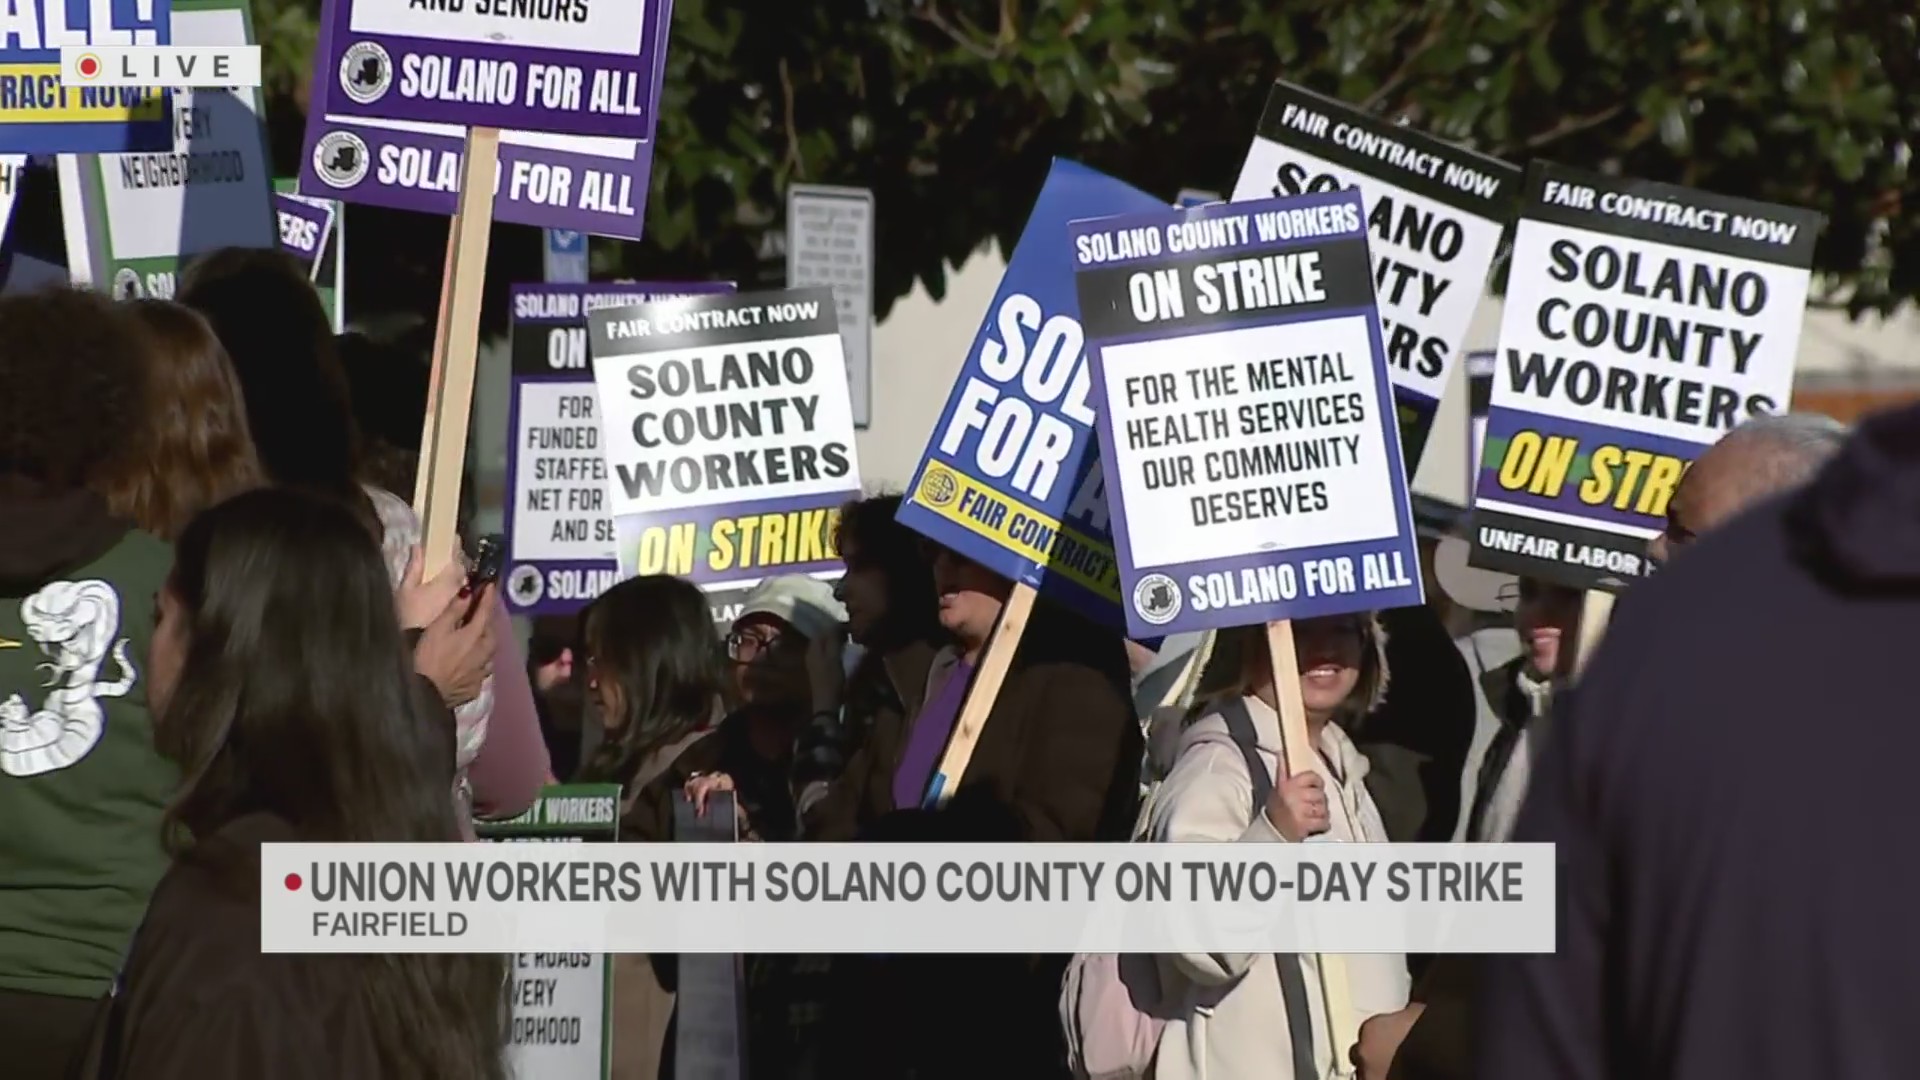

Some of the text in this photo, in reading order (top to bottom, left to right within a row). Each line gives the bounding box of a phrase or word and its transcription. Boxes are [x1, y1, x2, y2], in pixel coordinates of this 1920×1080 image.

[400, 53, 517, 106] SOLANO
[526, 64, 582, 110] FOR
[589, 70, 641, 115] ALL
[1281, 104, 1501, 199] FAIR CONTRACT NOW
[510, 161, 571, 204] FOR
[579, 171, 635, 216] ALL
[1272, 162, 1465, 263] SANO
[1543, 180, 1798, 246] FAIR CONTRACT NOW
[1076, 202, 1360, 264] SOLANO COUNTY WORKERS
[1128, 271, 1185, 323] ON
[1196, 251, 1325, 312] STRIKE
[1547, 238, 1768, 316] SOLANO
[515, 293, 579, 318] SOLANO
[607, 320, 651, 341] FAIR
[655, 306, 761, 335] CONTRACT
[768, 301, 819, 324] NOW
[549, 328, 586, 369] ON
[1537, 297, 1763, 376] COUNTY
[627, 346, 813, 400] SOLANO
[1126, 352, 1353, 408] FOR THE MENTAL
[559, 396, 593, 419] FOR
[632, 395, 819, 448] COUNTY
[1127, 393, 1364, 451] HEALTH SERVICES
[528, 427, 598, 450] FUNDED
[940, 376, 1074, 501] FOR
[1143, 435, 1360, 490] OUR COMMUNITY
[615, 442, 850, 499] WORKERS
[1499, 431, 1694, 517] ON STR
[527, 489, 602, 511] NET FOR
[1191, 482, 1329, 527] DESERVES
[551, 520, 588, 542] AND
[638, 522, 696, 577] ON
[958, 486, 1011, 530] FAIR
[1008, 513, 1112, 582] CONTRACT
[1480, 527, 1559, 560] UNFAIR
[1564, 542, 1640, 574] LABOR
[1188, 561, 1298, 612] SOLANO
[1305, 554, 1356, 596] FOR
[1363, 550, 1412, 589] ALL
[546, 797, 614, 823] WORKERS
